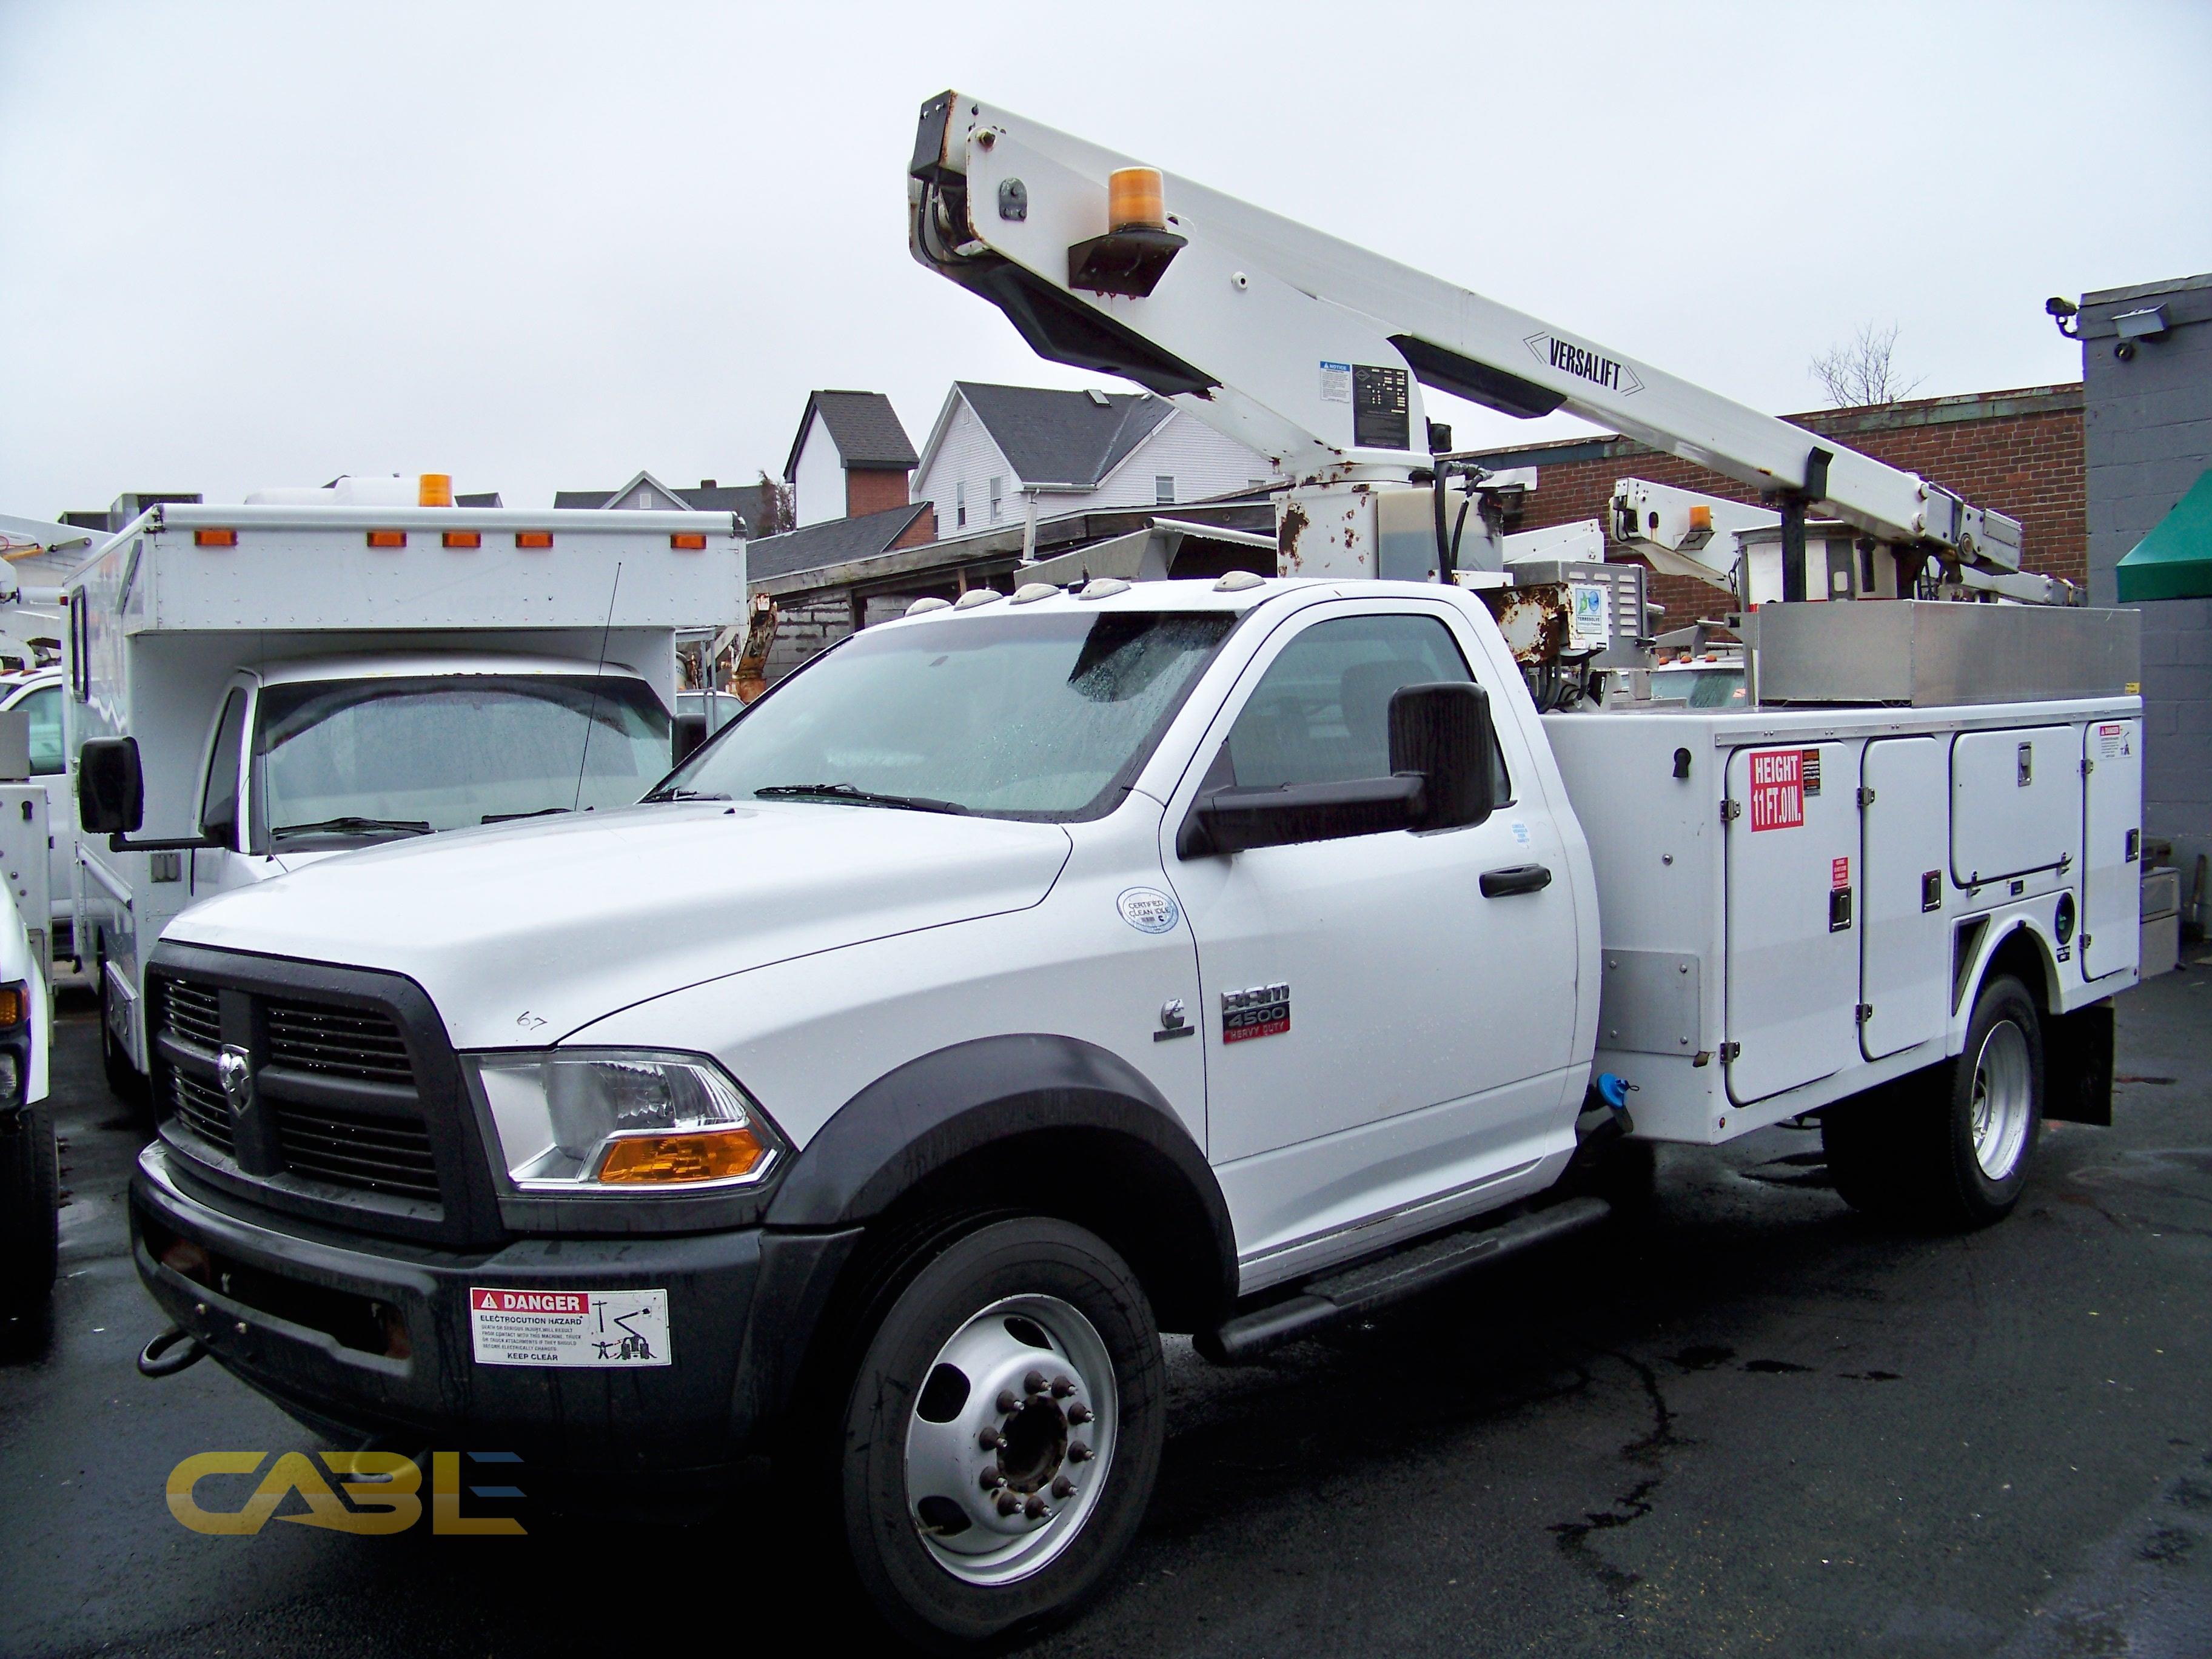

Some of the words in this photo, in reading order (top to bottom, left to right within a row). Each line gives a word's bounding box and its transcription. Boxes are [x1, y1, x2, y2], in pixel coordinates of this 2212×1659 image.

[1550, 337, 1621, 390] VERSALIFT
[1755, 756, 1798, 784] HEIGHT
[1753, 789, 1765, 826] 11
[1128, 900, 1164, 910] CERTIFIED
[1129, 909, 1153, 917] CLEAN
[1221, 981, 1290, 1012] RAM
[1228, 1006, 1286, 1027] 4500
[1231, 1026, 1259, 1039] HEAVY
[1263, 1021, 1285, 1033] DUTY
[503, 1293, 580, 1311] DANGER
[480, 1315, 546, 1324] ELECTROCUTION
